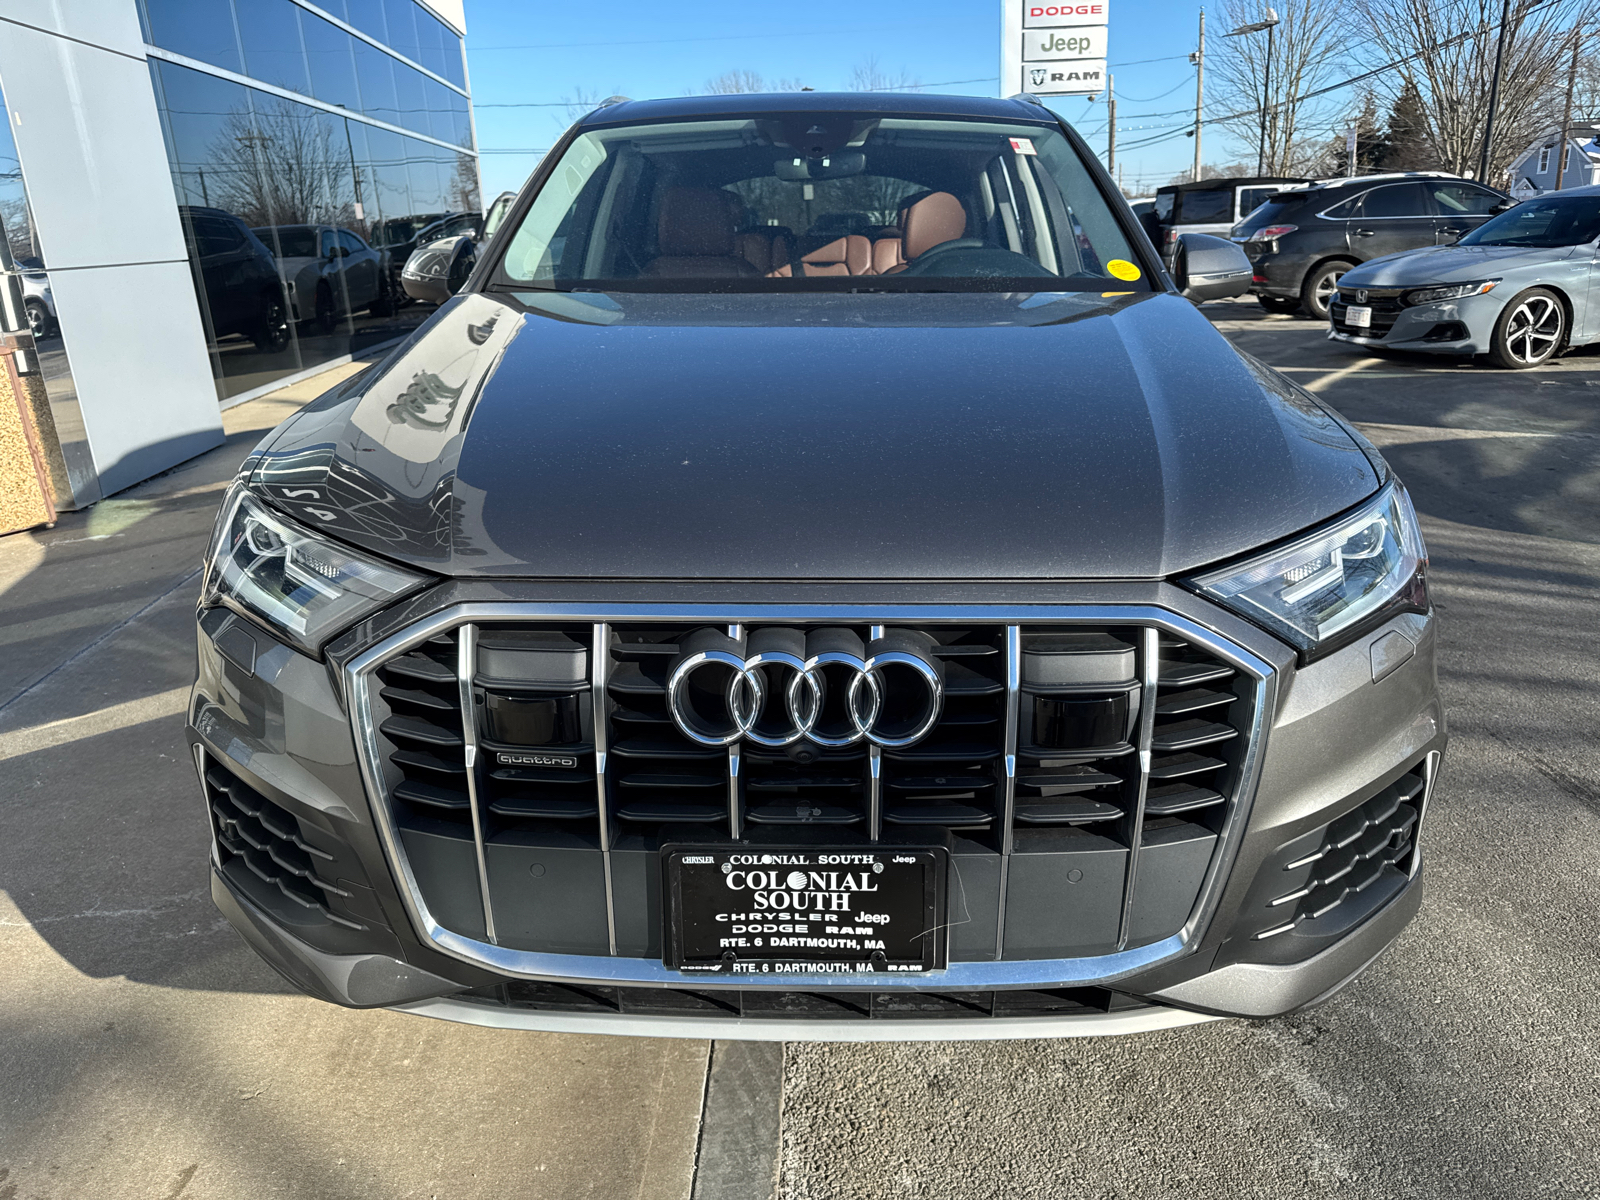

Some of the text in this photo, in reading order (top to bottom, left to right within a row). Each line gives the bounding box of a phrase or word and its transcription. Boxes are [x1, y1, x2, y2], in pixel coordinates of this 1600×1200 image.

[1030, 5, 1103, 17] DODGE
[1040, 33, 1091, 55] Jeep
[1050, 71, 1100, 82] RAM
[500, 755, 573, 766] quattro
[681, 855, 715, 864] CHRYSLER
[729, 854, 875, 865] COLONIAL SOUTH
[892, 855, 916, 864] Jeep
[725, 870, 878, 892] COLONIAL
[753, 891, 851, 911] SOUTH
[715, 911, 891, 925] CHRYSLER Jeep
[732, 924, 874, 936] DODGE RAM
[719, 937, 886, 950] RTE. 6 DARTMOUTH, MA
[732, 963, 874, 973] RTE. 6 DARTMOUTH, MA
